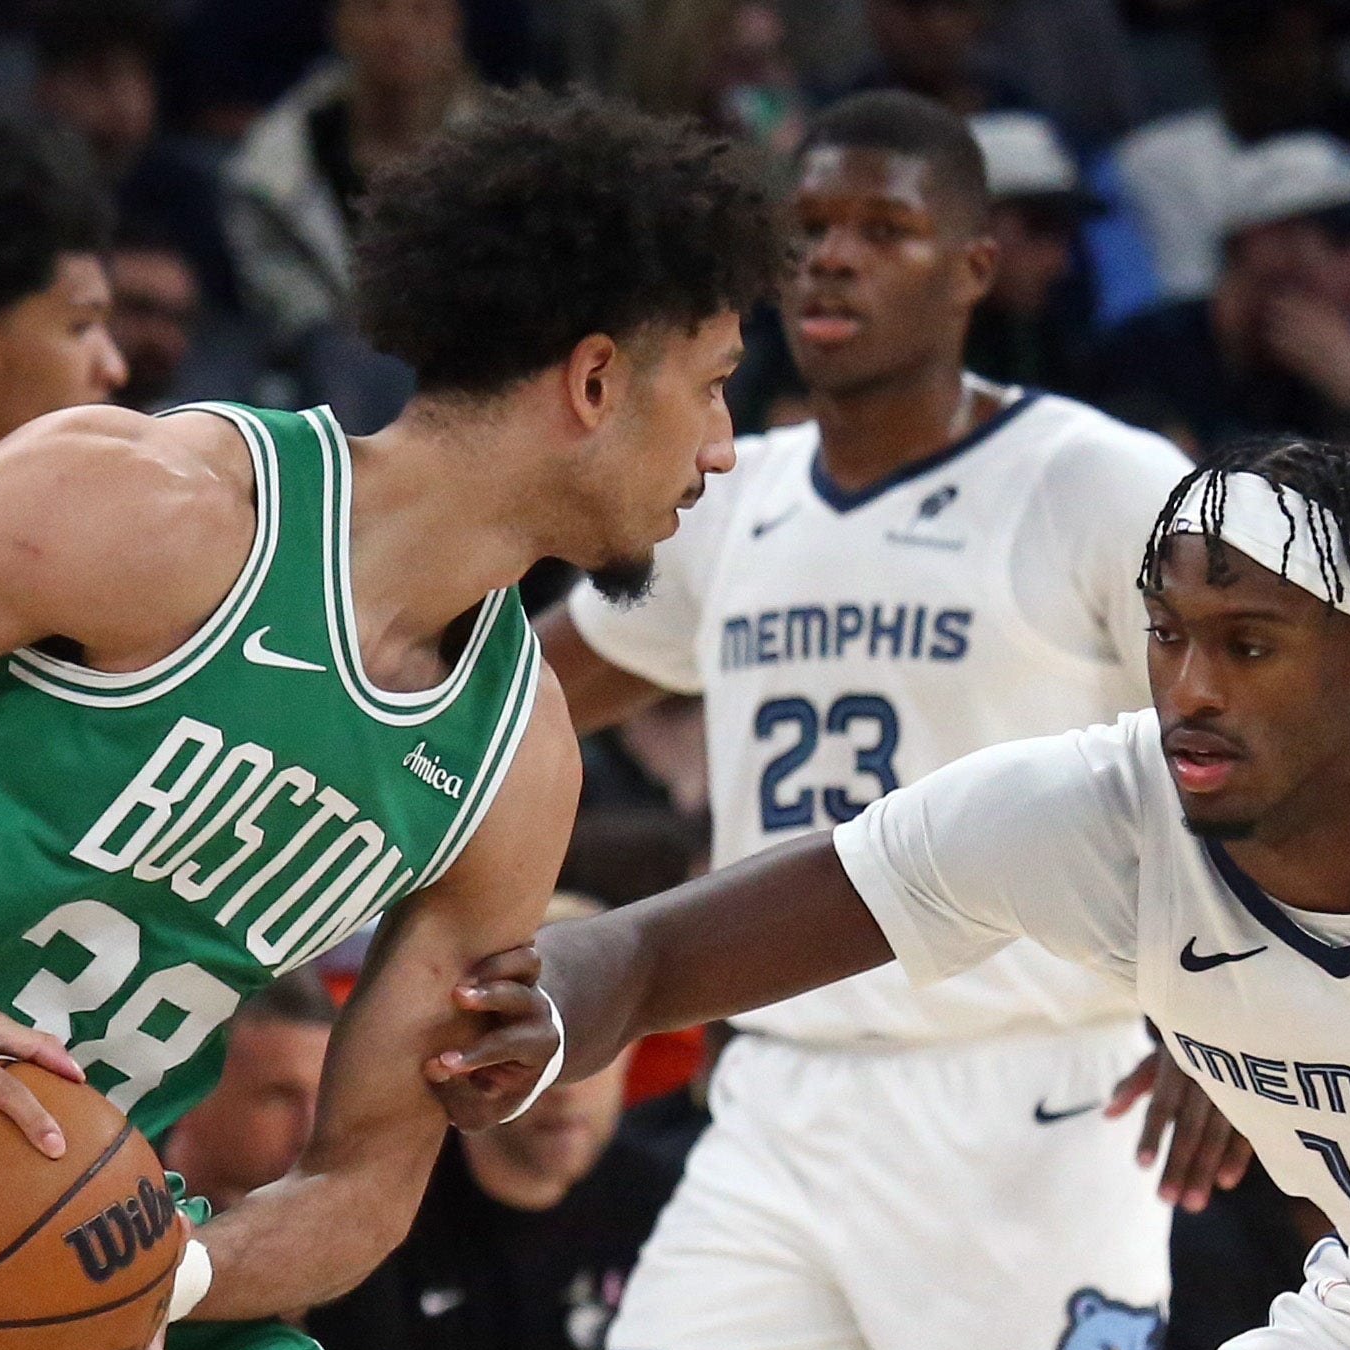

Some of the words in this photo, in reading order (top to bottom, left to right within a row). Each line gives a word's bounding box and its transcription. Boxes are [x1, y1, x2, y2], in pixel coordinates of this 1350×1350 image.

[721, 603, 973, 672] MEMPHIS
[403, 740, 465, 799] Amica
[754, 692, 900, 832] 23
[69, 715, 414, 977] BOSTON
[11, 898, 242, 1116] 38
